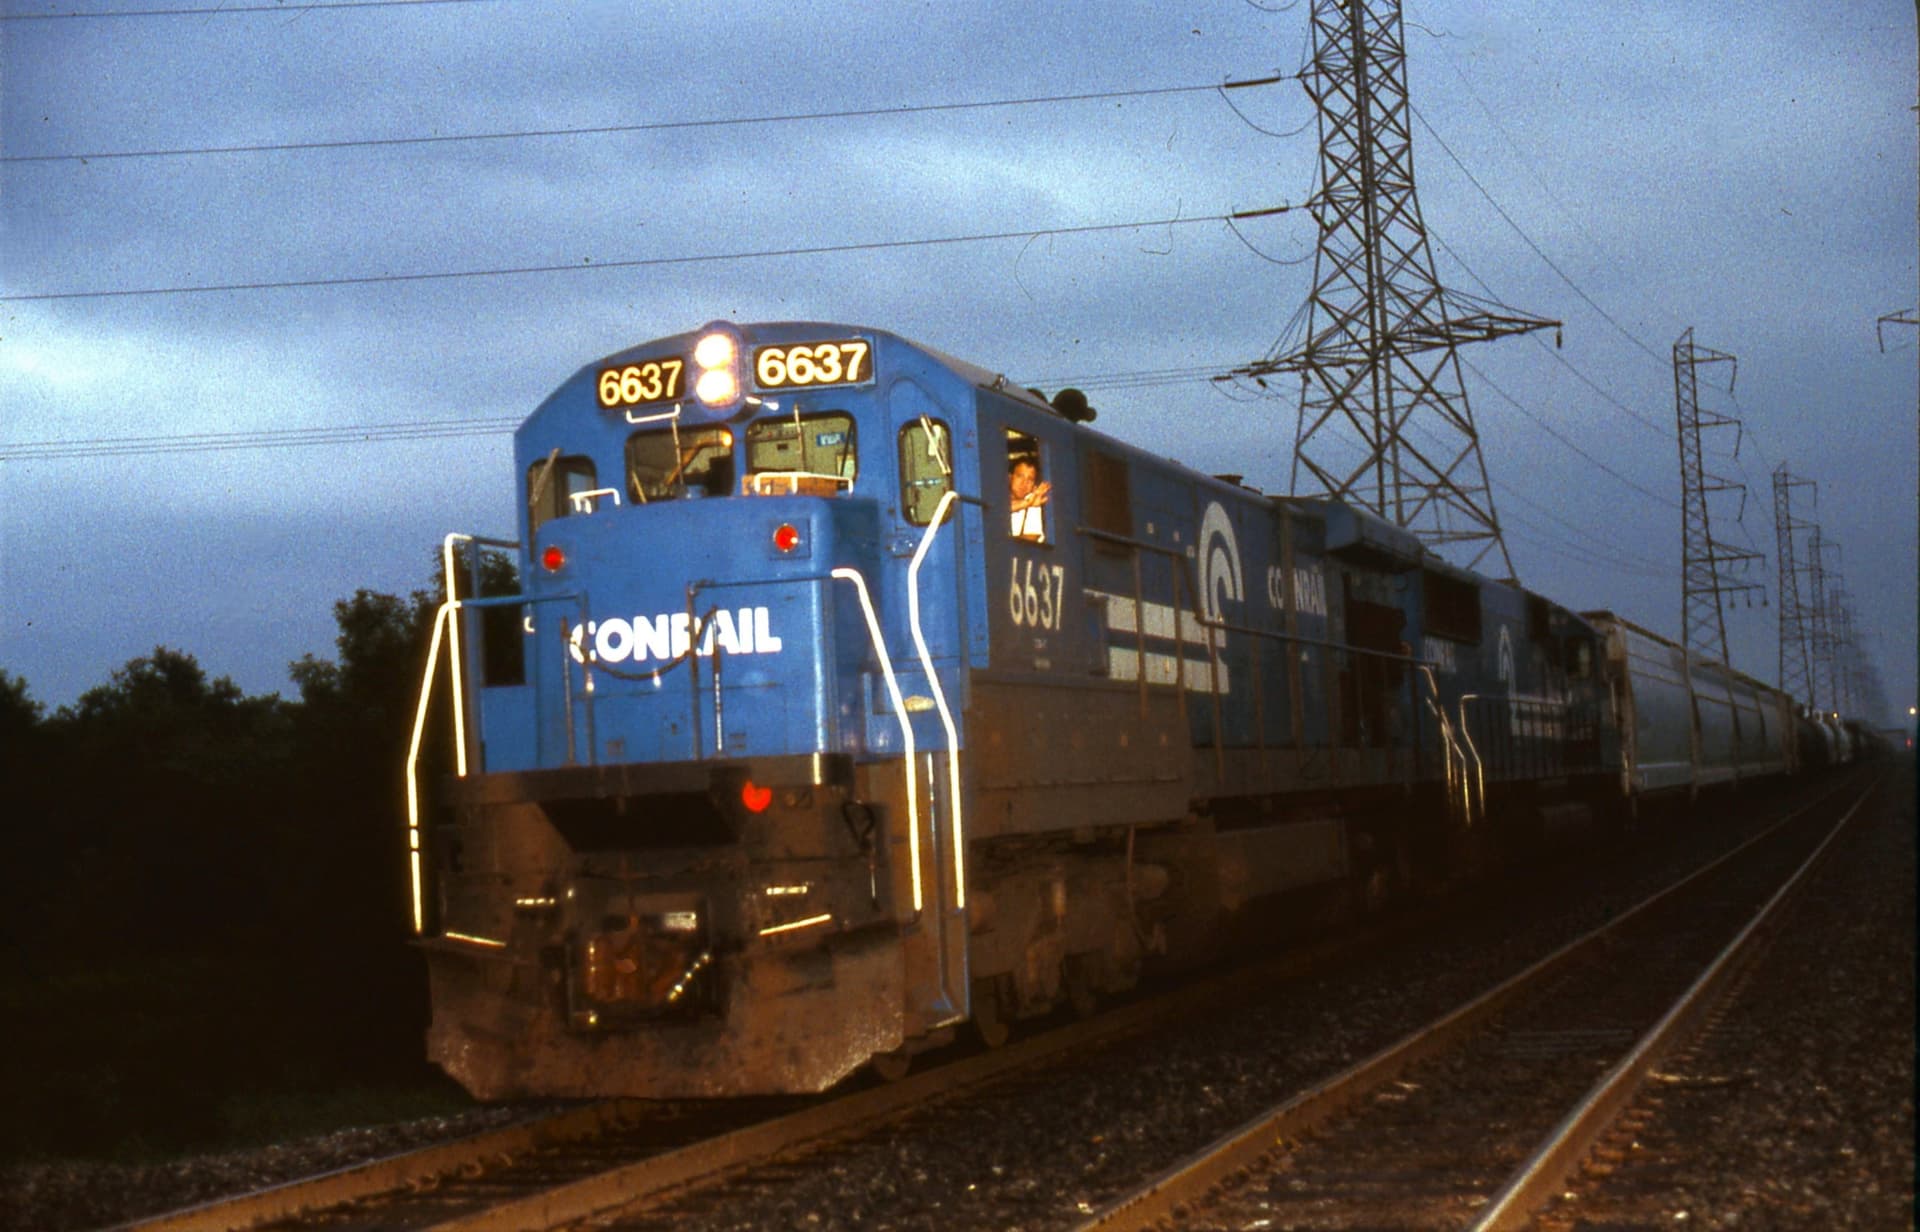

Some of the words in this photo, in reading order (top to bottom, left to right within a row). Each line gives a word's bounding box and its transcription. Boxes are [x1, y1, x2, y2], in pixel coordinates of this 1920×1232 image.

[599, 360, 683, 406] 6637
[757, 342, 868, 387] 6637
[1010, 557, 1064, 631] 6637
[569, 606, 783, 664] CONRAIL
